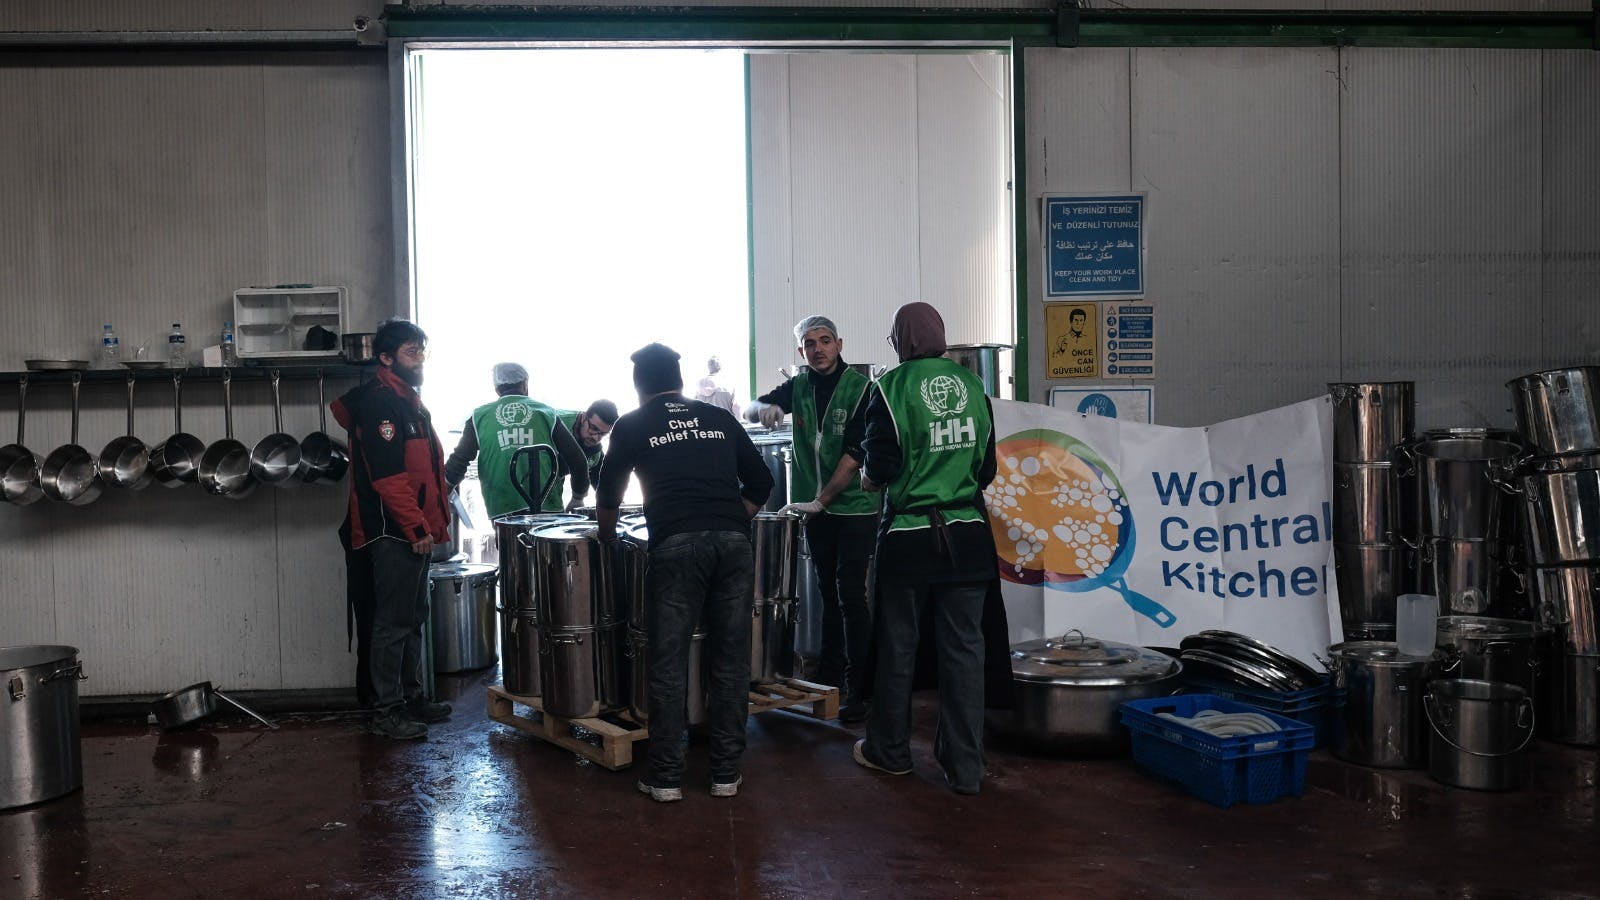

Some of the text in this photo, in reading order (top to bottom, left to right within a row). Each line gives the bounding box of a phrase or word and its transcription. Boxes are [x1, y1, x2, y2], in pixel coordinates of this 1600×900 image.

[1062, 205, 1133, 216] İŞ YERİNİZİ TEMİZ
[1052, 221, 1139, 230] VE DÜZENLİ TUTUNUZ
[1071, 348, 1093, 357] ÖNCE
[668, 417, 699, 430] Chef
[649, 429, 726, 448] Relief Team
[1152, 458, 1287, 507] World
[1160, 501, 1331, 553] Central
[1162, 559, 1327, 598] Kitche
